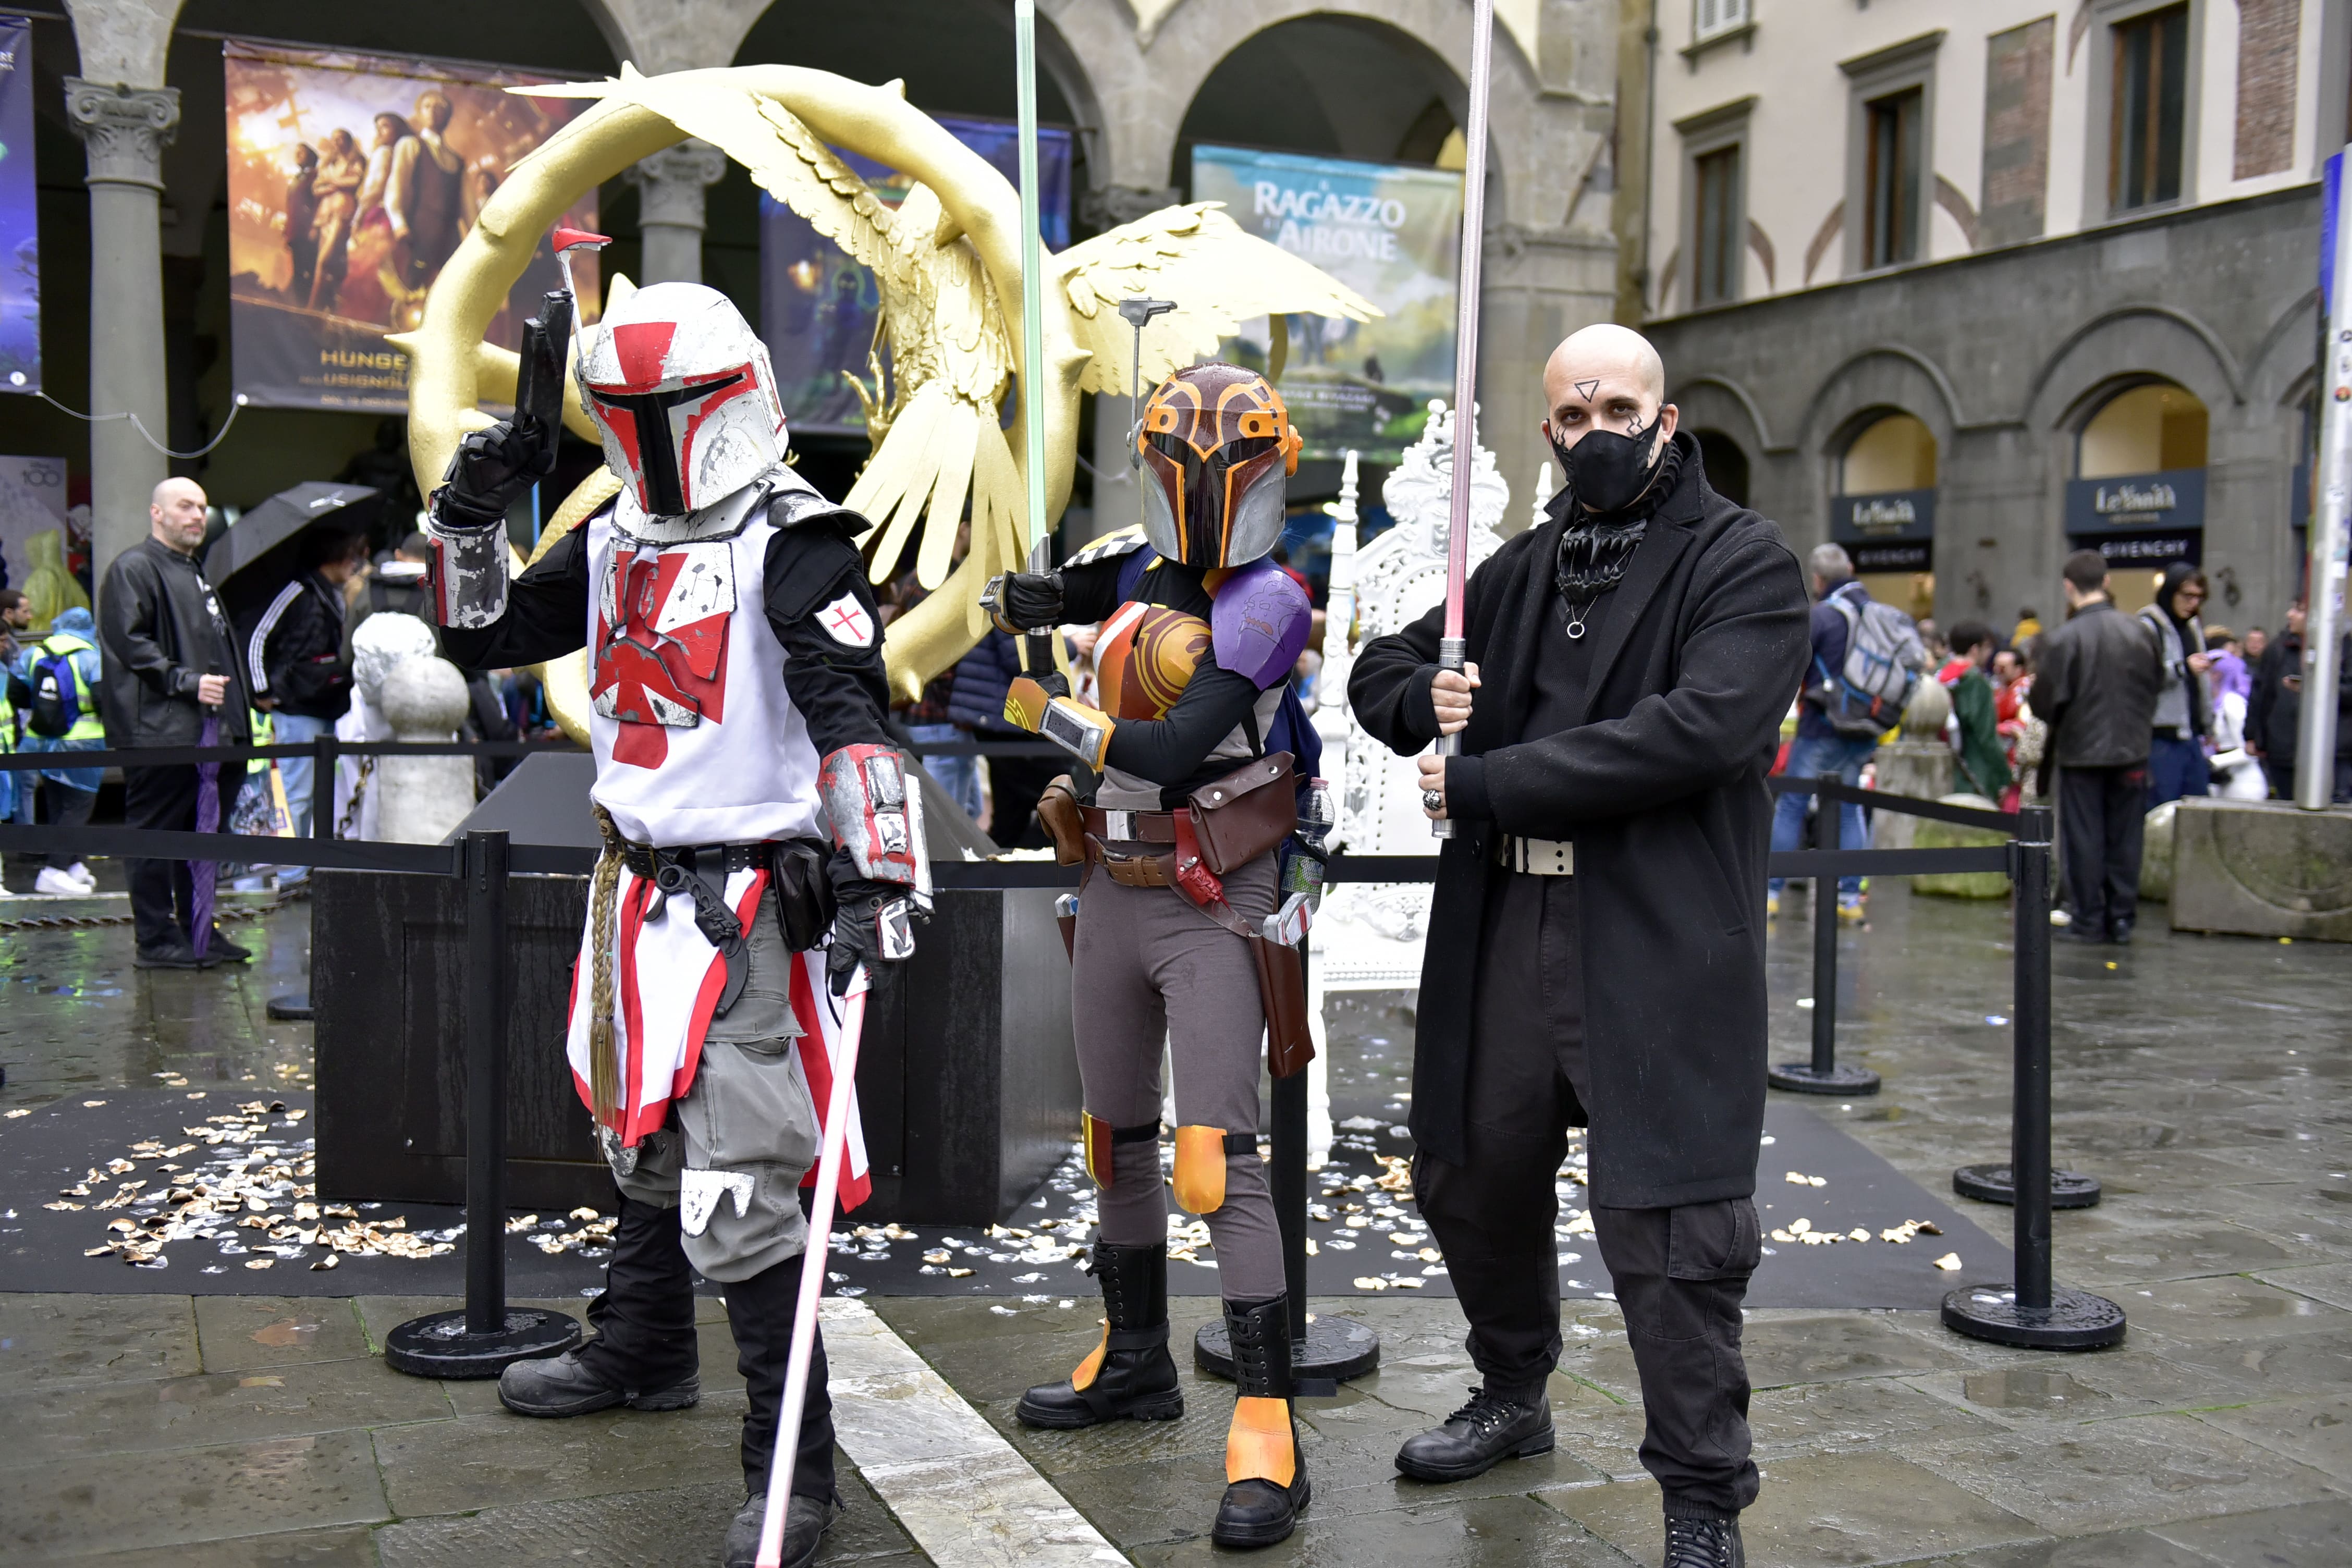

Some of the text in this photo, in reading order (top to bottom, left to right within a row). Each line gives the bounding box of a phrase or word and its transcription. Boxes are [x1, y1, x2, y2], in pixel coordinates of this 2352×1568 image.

[1254, 181, 1406, 228] RAGAZZO
[321, 350, 410, 370] HUNGE
[323, 373, 410, 391] USIGNOL
[1857, 548, 1926, 566] GIVENCHY
[2100, 539, 2188, 559] GIVENCHY
